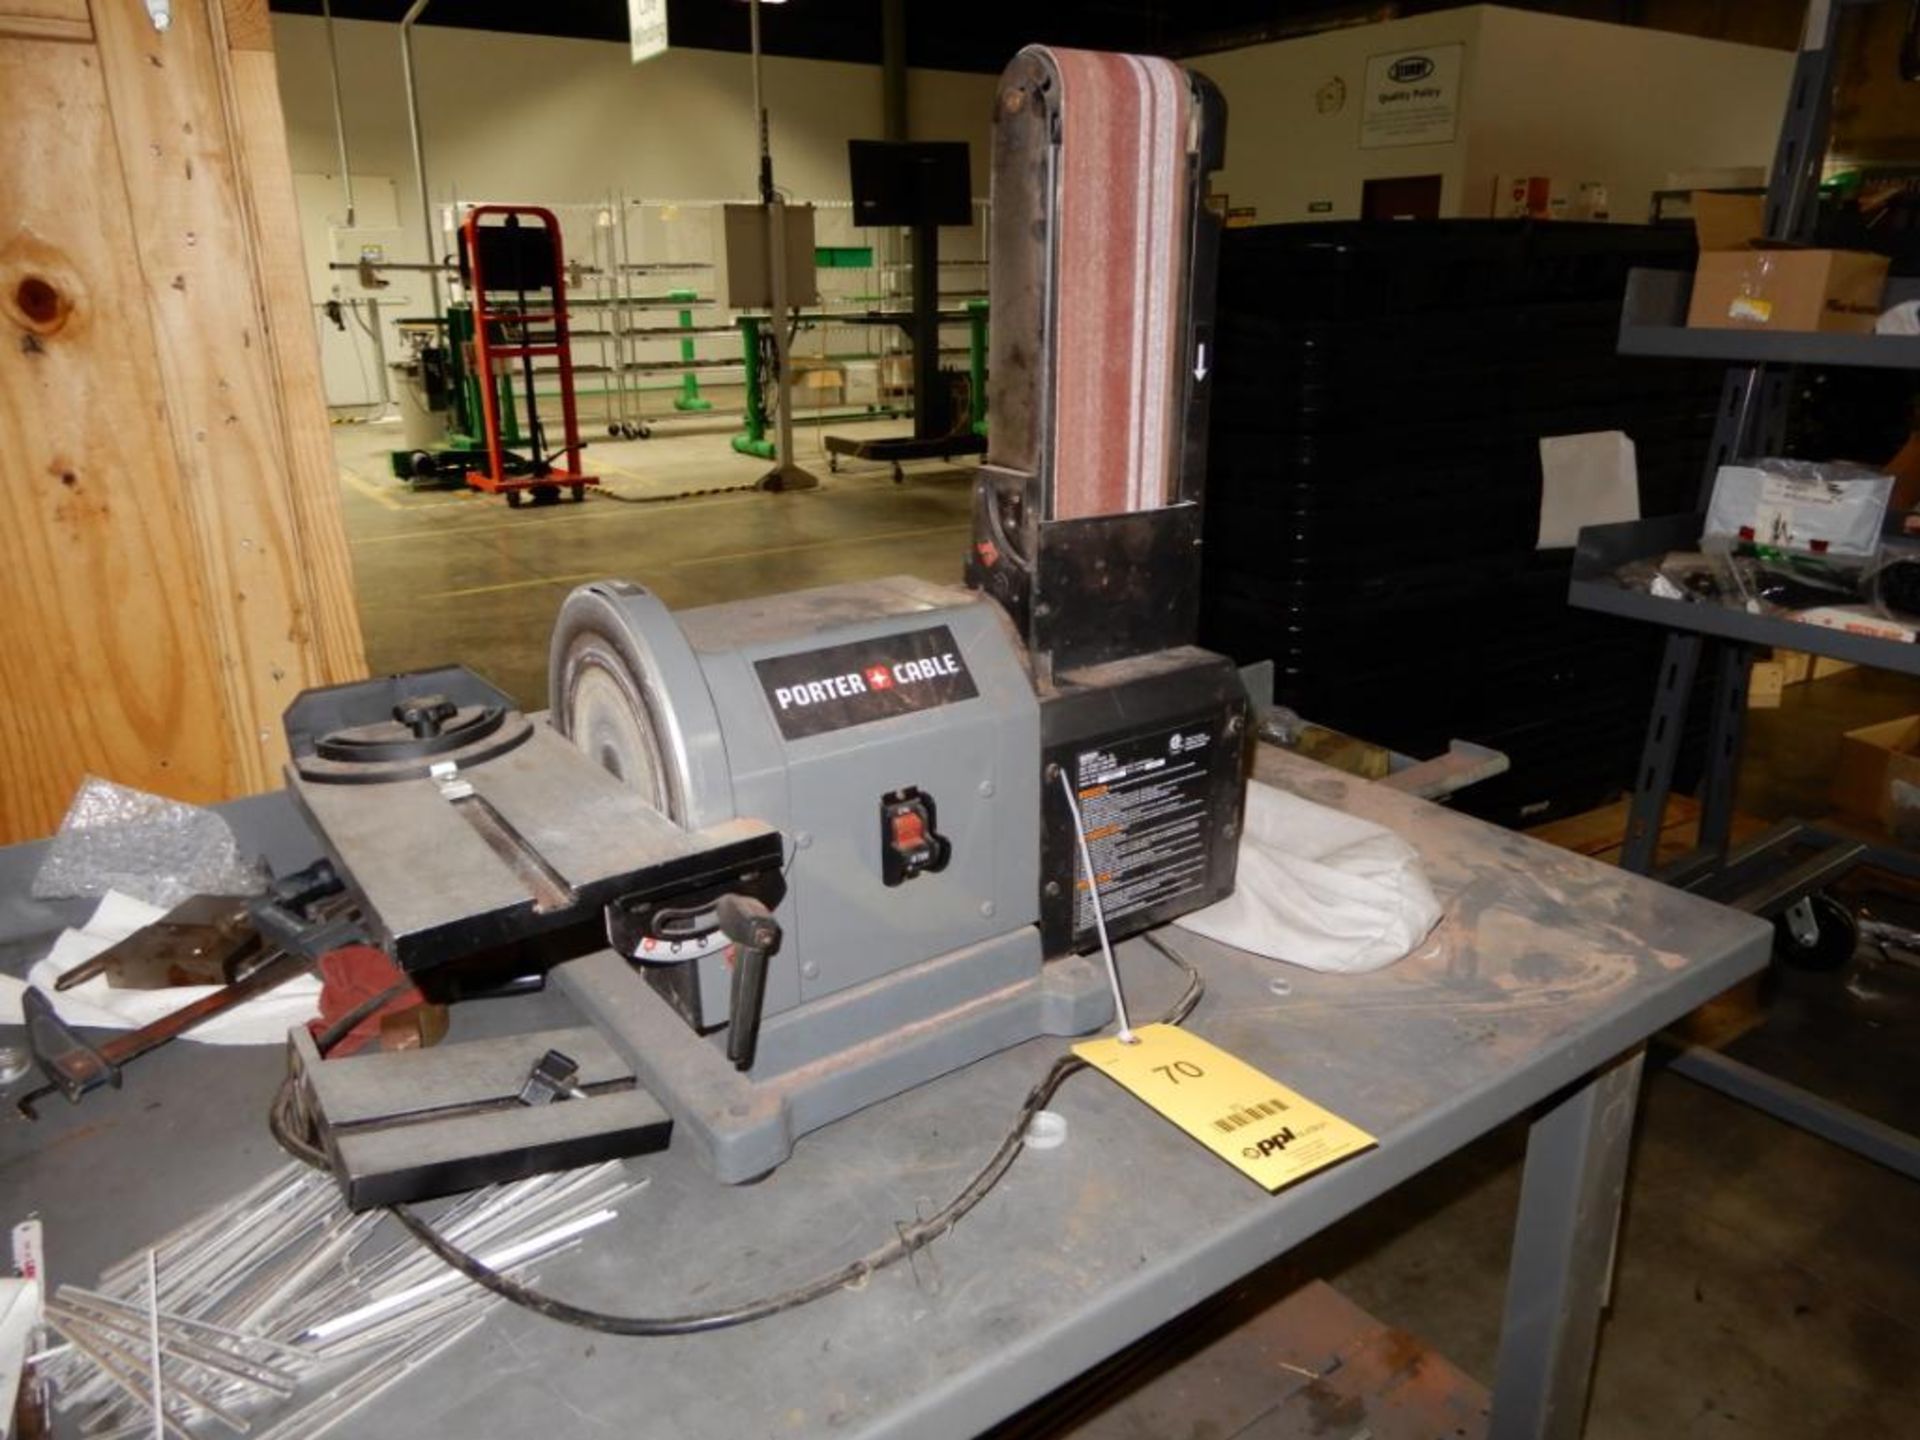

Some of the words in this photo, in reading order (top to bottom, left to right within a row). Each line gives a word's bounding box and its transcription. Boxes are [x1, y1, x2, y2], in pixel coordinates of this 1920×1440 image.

[1379, 91, 1410, 105] Quality
[1413, 88, 1440, 99] Policy
[775, 673, 866, 710] PORTER
[892, 652, 960, 684] CABLE
[1151, 1060, 1205, 1084] 70
[1256, 1126, 1296, 1157] ppl
